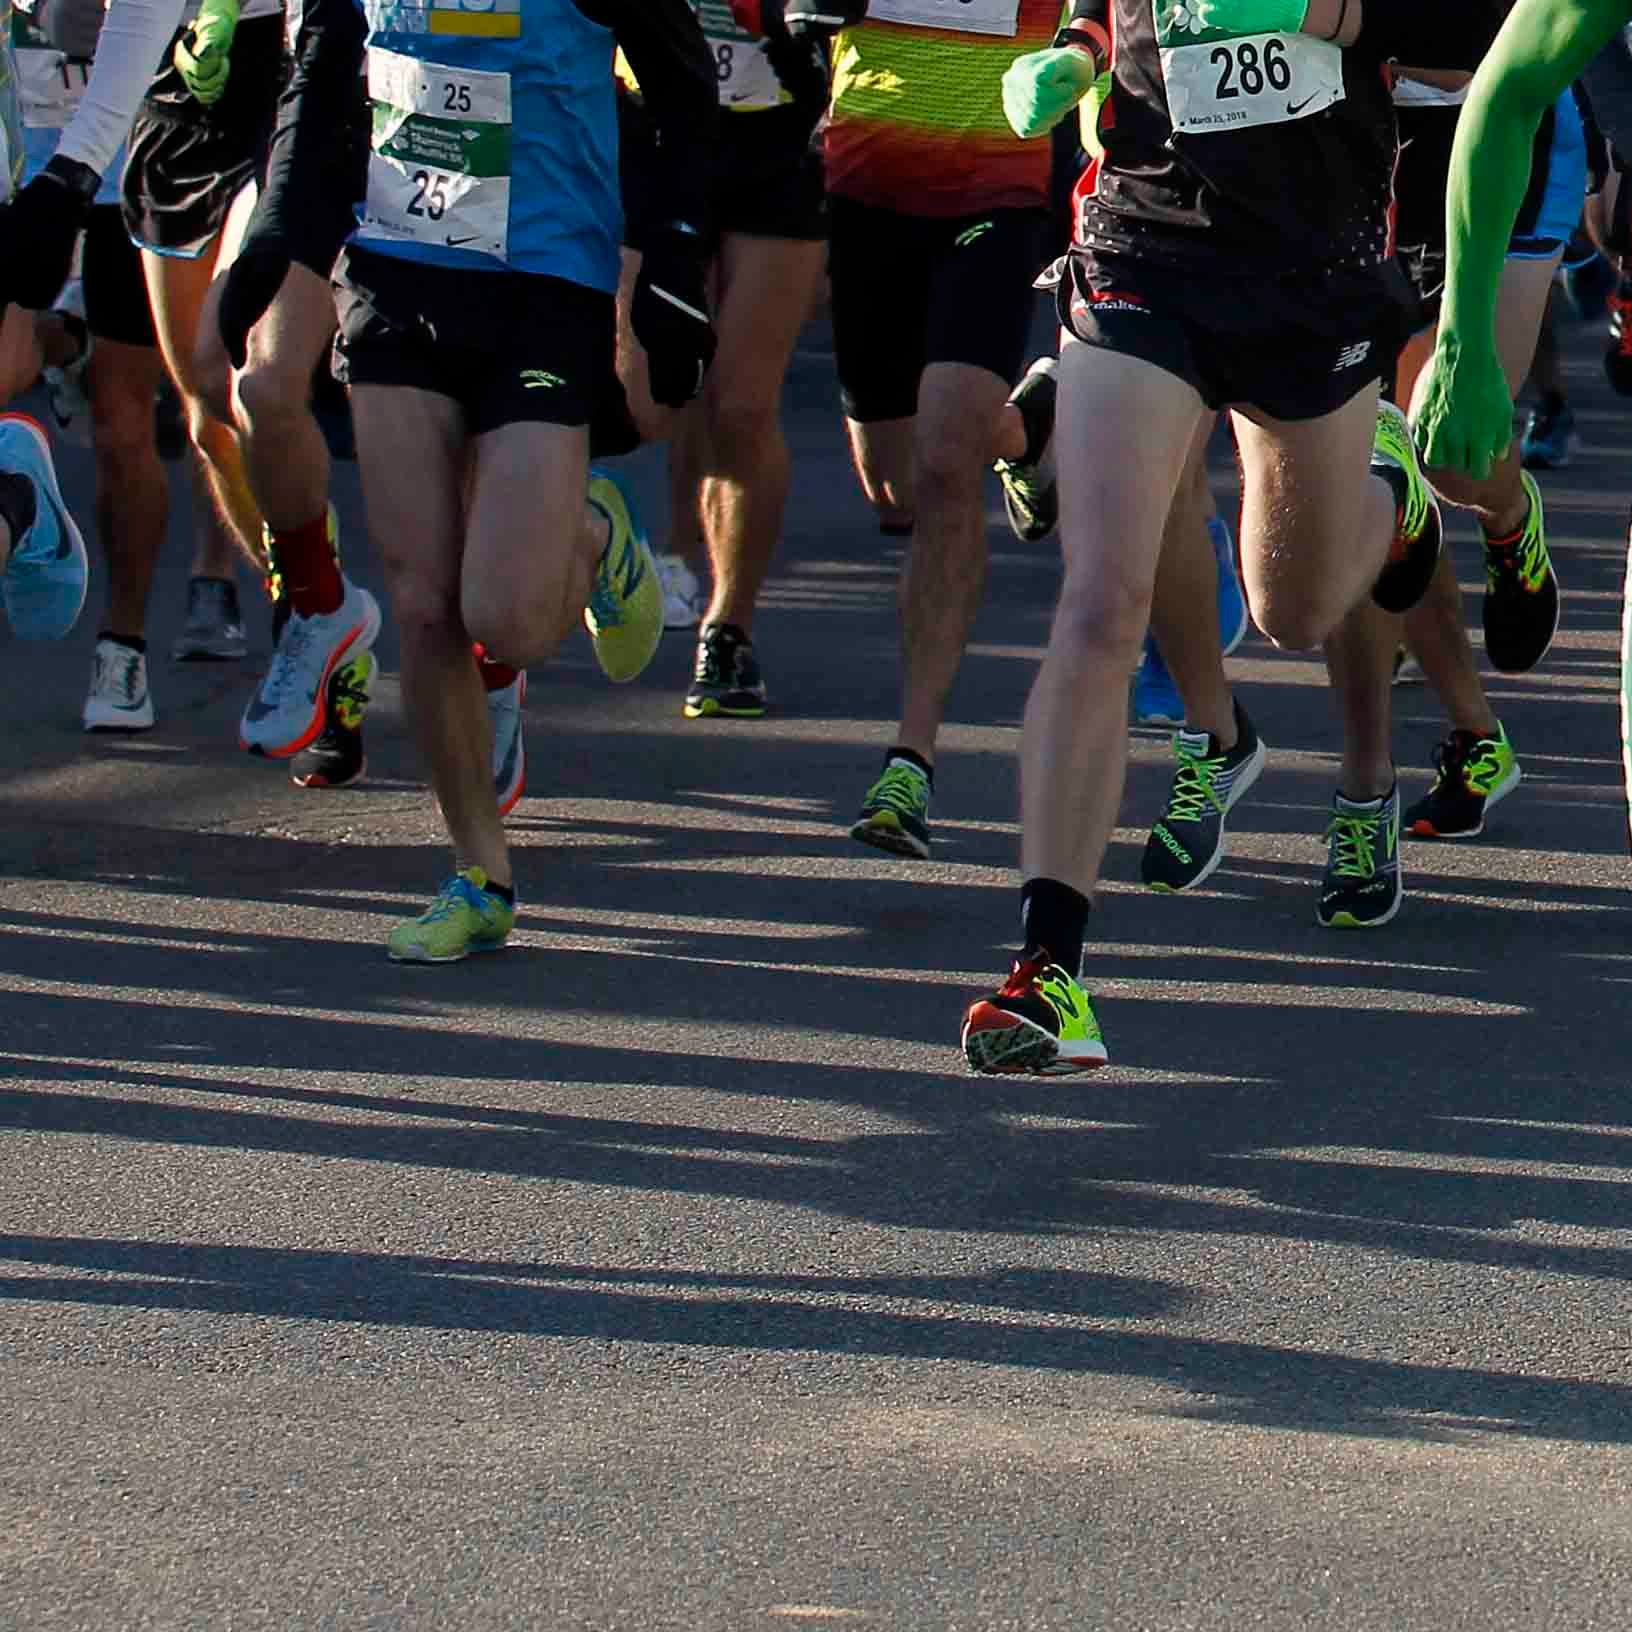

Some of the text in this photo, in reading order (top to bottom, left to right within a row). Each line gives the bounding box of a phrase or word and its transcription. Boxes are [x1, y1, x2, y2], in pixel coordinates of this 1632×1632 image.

[1210, 39, 1291, 100] 286
[443, 83, 471, 112] 25
[1188, 116, 1216, 126] March
[1226, 111, 1248, 121] 2018
[406, 170, 450, 221] 25
